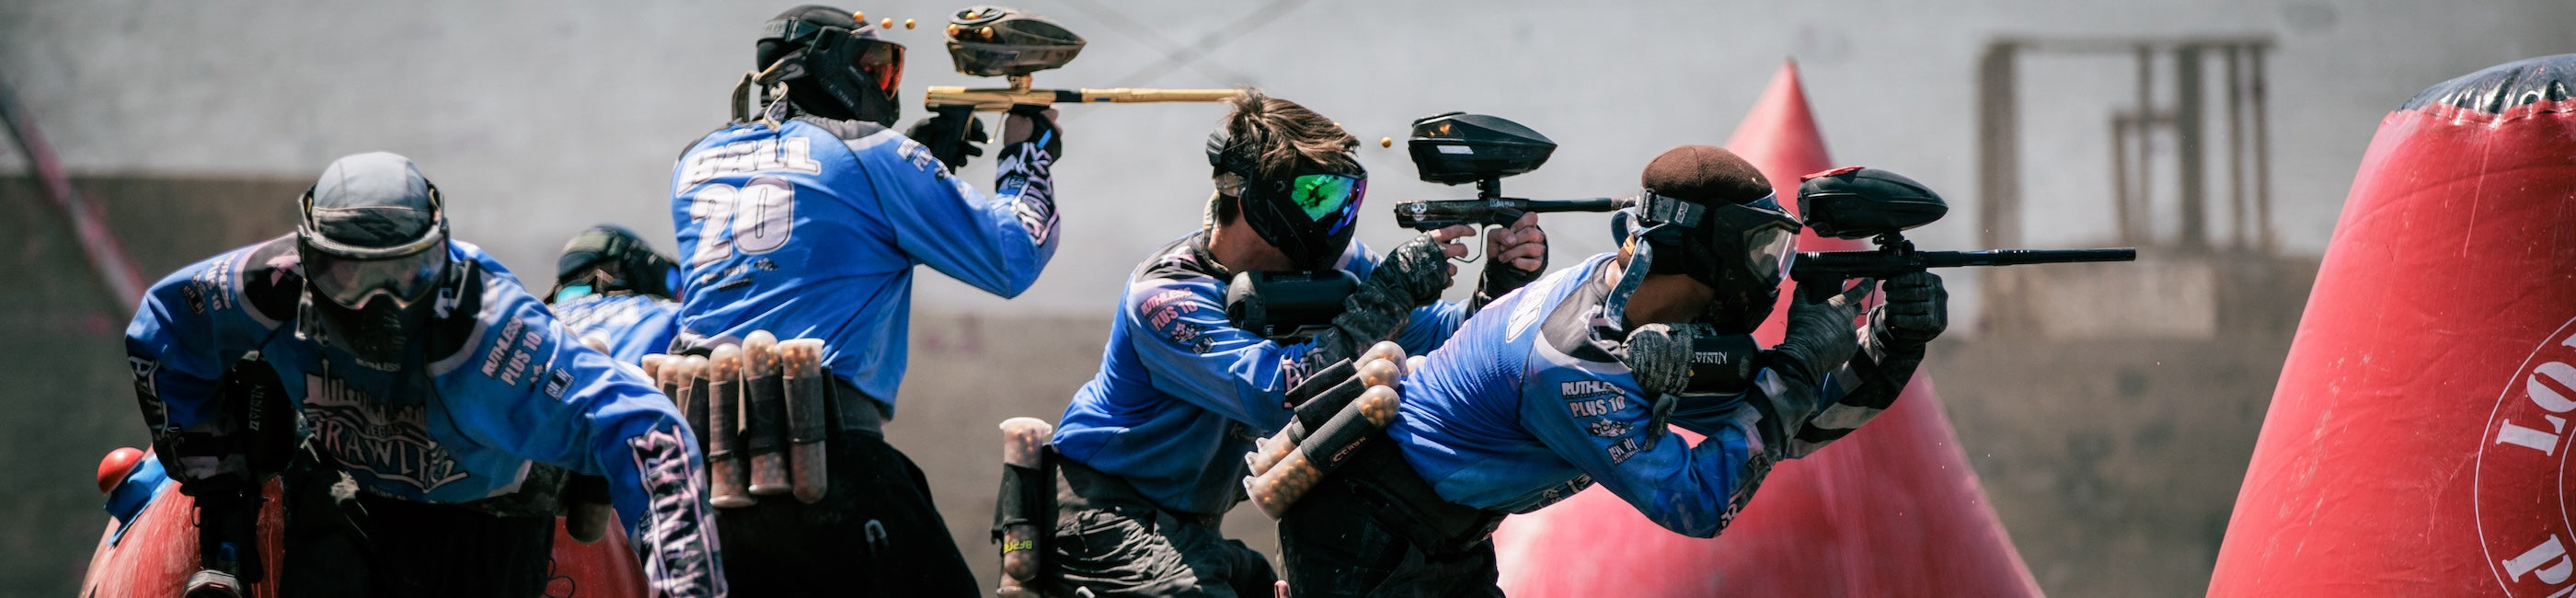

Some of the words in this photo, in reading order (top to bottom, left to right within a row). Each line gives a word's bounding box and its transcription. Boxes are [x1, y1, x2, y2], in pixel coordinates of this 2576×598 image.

[690, 173, 795, 271] 20
[1150, 305, 1179, 331] PLUS
[1178, 300, 1199, 314] 10
[481, 316, 523, 378] RUTHLESS
[500, 349, 532, 386] PLUS
[522, 331, 543, 351] 10
[1695, 351, 1728, 365] NINJA
[1570, 398, 1608, 418] PLUS
[1608, 396, 1627, 412] 10
